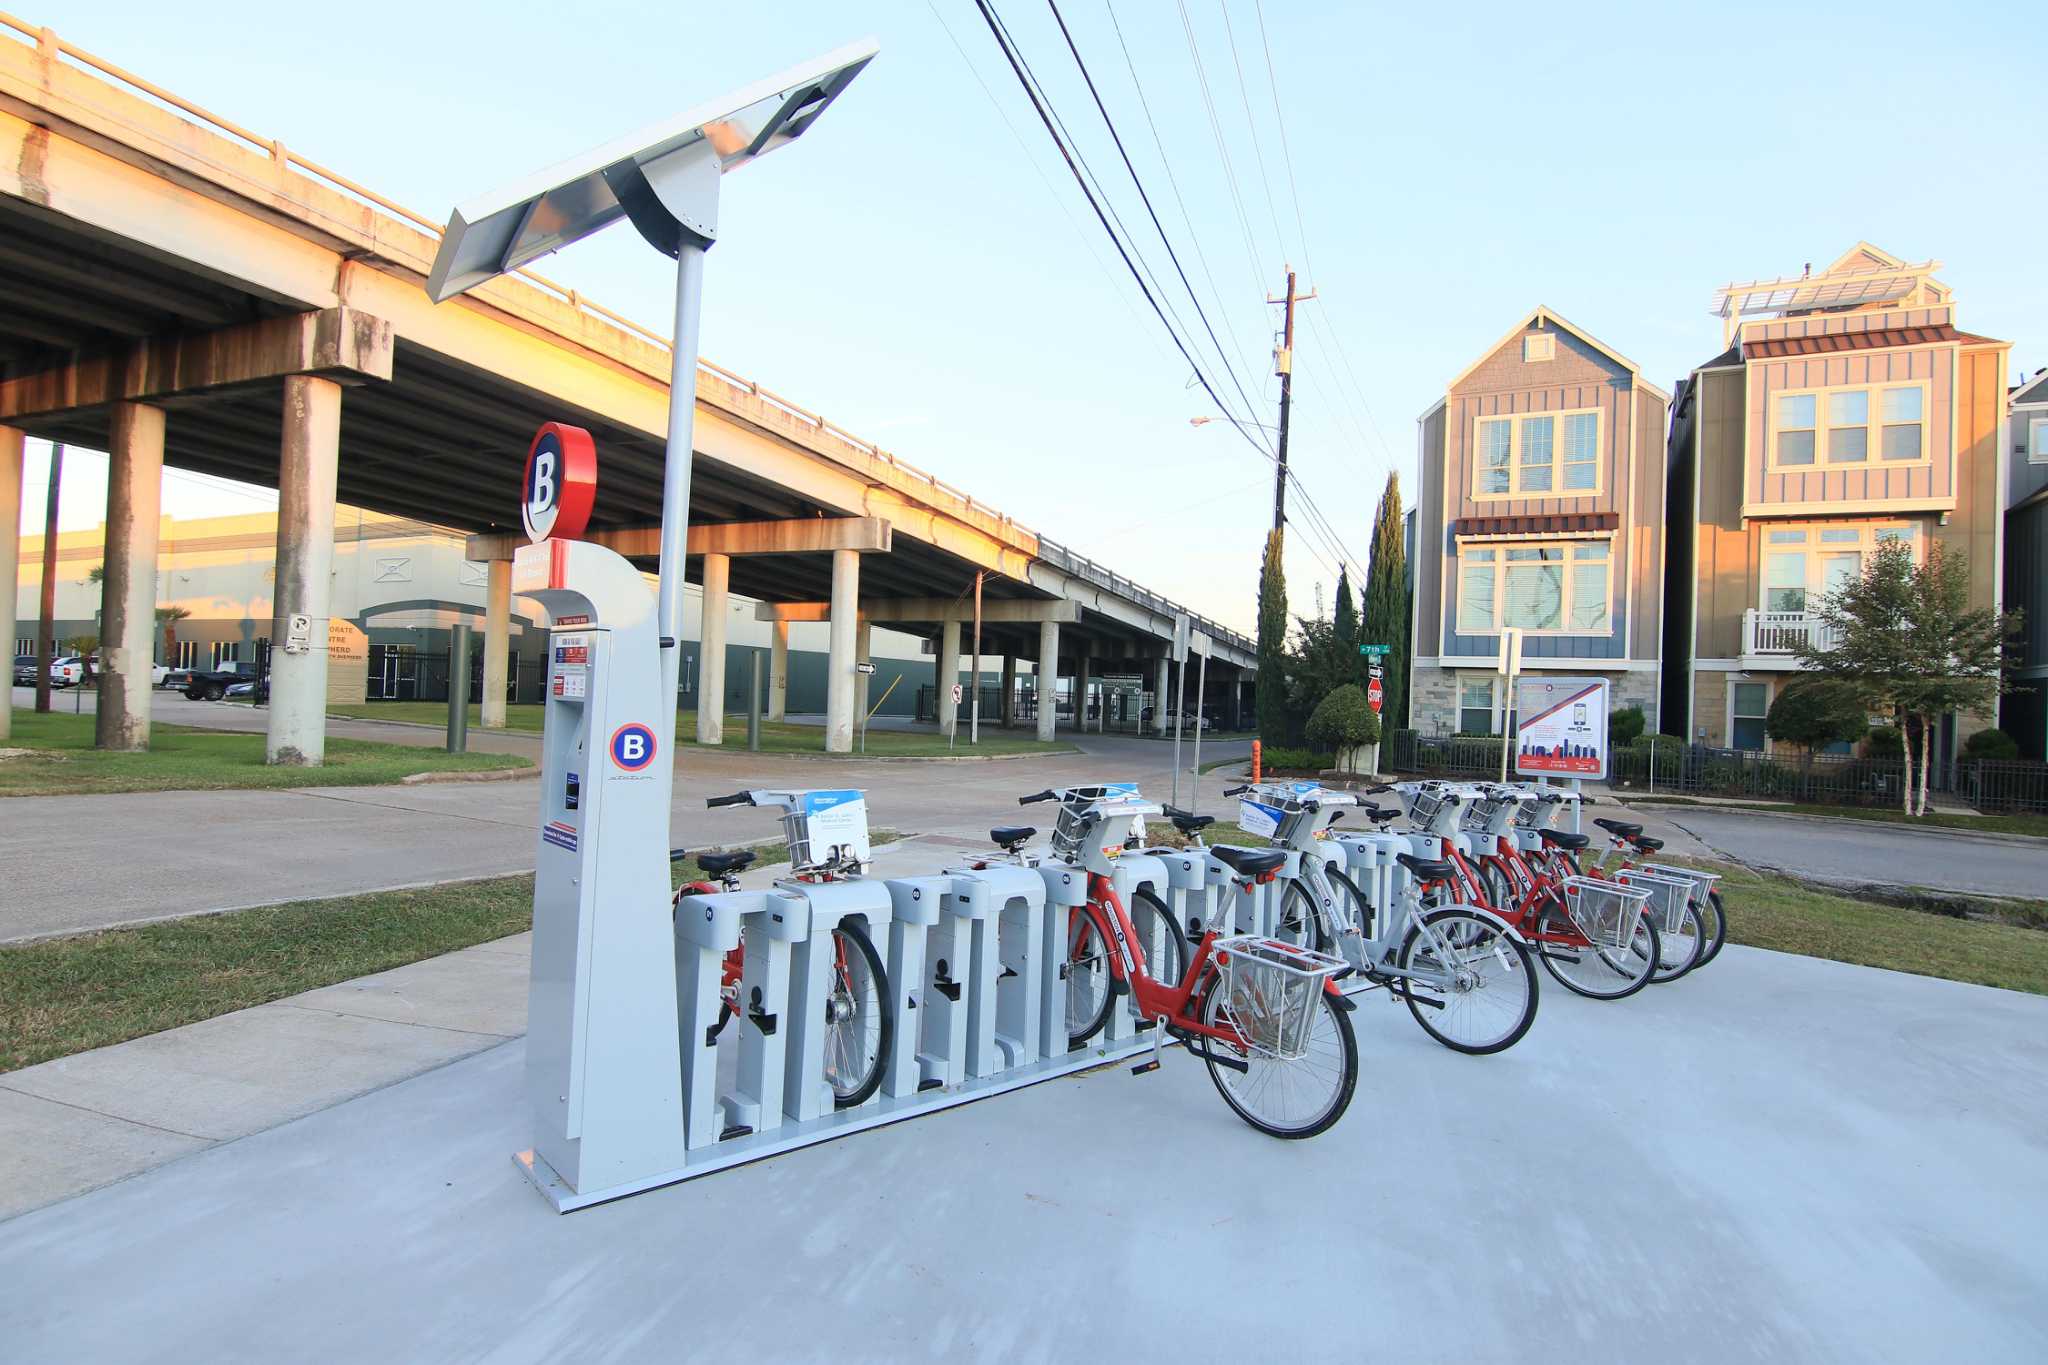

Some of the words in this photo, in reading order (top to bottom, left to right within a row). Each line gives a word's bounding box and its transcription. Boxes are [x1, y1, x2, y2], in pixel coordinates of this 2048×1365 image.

[533, 451, 555, 514] B
[1369, 689, 1381, 702] STOP
[623, 734, 645, 760] B
